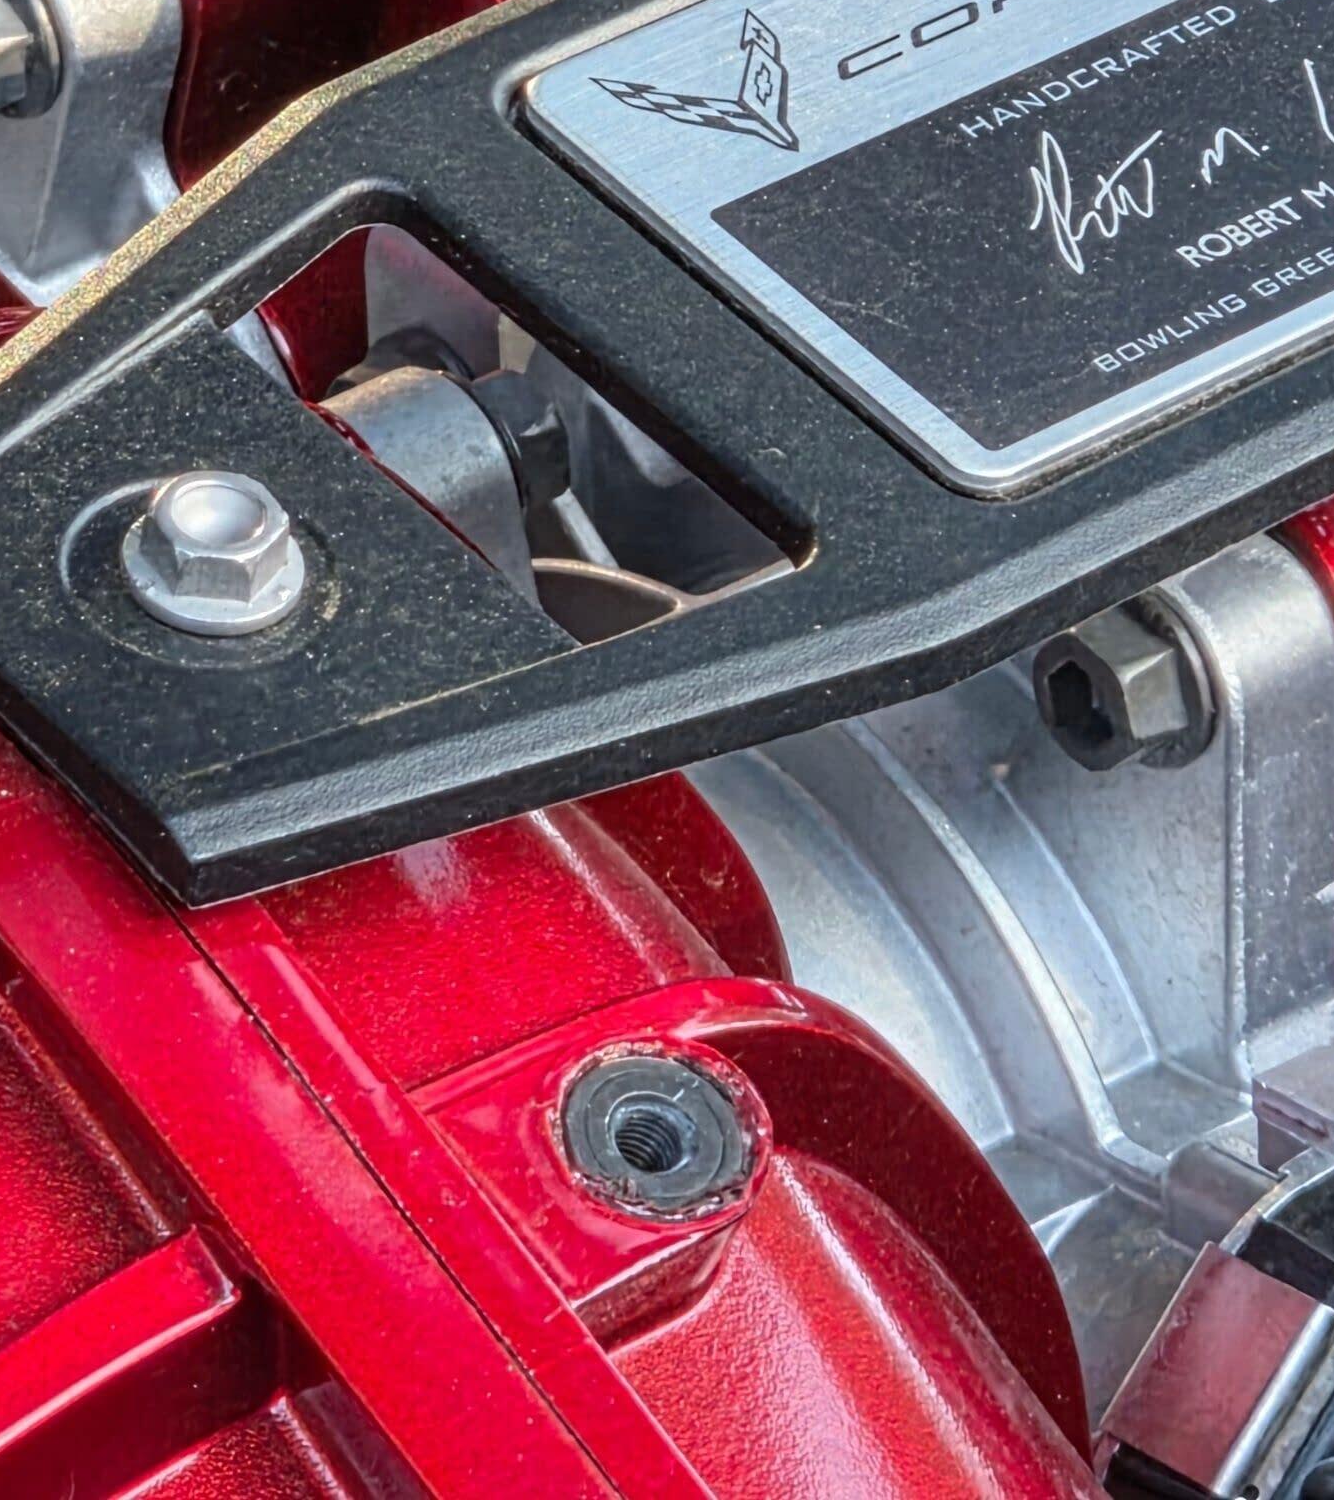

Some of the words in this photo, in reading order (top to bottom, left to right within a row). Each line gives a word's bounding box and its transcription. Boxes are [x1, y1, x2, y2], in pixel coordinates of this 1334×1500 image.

[960, 4, 1236, 138] HANDCRAFTED
[1175, 197, 1302, 268] ROBERT
[1093, 293, 1247, 373] BOWLING
